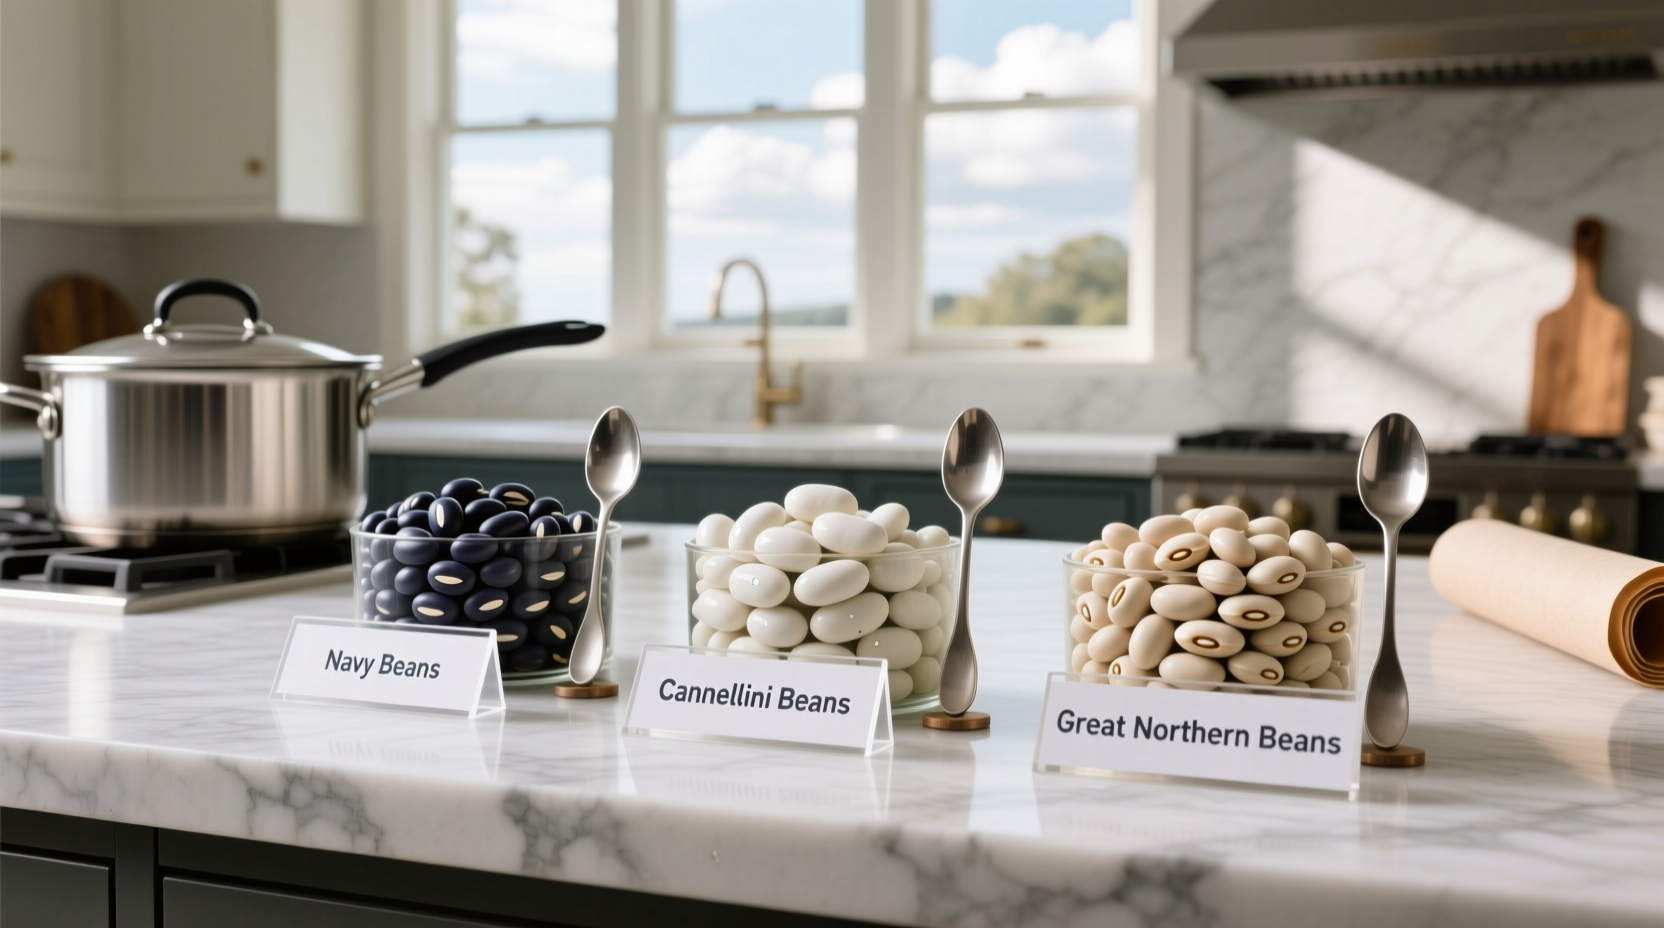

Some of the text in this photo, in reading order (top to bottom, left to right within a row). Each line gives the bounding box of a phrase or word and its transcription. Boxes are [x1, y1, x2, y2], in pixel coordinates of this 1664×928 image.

[324, 648, 441, 679] Navy Beans
[658, 678, 851, 715] Cannellini Beans
[1056, 708, 1342, 755] Great Northern Beans
